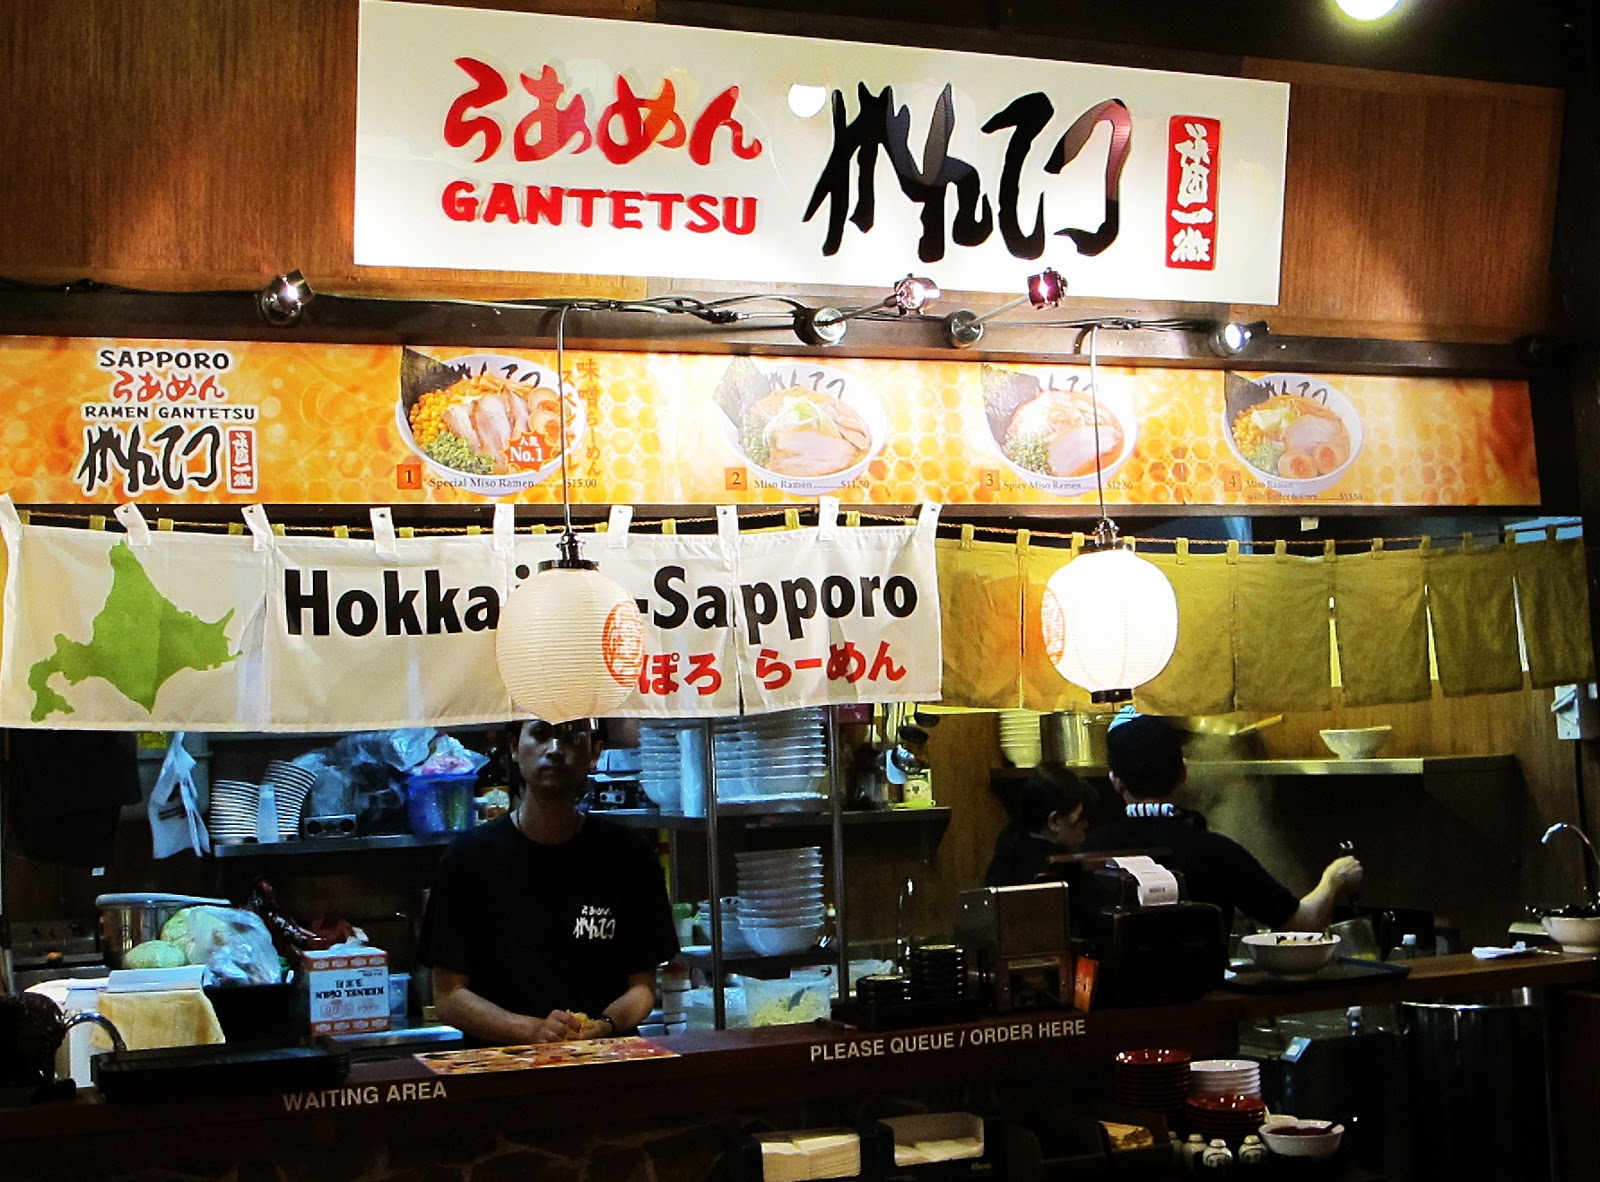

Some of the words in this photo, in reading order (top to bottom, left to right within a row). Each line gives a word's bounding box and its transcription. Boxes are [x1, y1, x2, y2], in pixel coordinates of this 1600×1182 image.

[443, 56, 763, 166] らあめん
[442, 180, 758, 236] GANTETSU
[100, 350, 230, 370] SAPPORO
[112, 370, 225, 402] らあめん
[85, 405, 149, 418] RAMEN
[158, 407, 255, 421] GANTETSU
[509, 446, 543, 463] No.1
[404, 469, 413, 484] 1
[429, 477, 468, 489] Special
[470, 478, 496, 488] Miso
[499, 477, 534, 488] Ramen
[732, 471, 741, 485] 2
[754, 479, 778, 489] Miso
[780, 479, 813, 489] Ramen
[985, 473, 994, 486] 3
[1228, 474, 1237, 487] 4
[1003, 481, 1027, 491] Spicy
[1030, 481, 1051, 490] Miso
[1053, 480, 1082, 490] Ramen
[756, 640, 907, 691] らーめん
[810, 1038, 885, 1062] PLEASE
[890, 1031, 955, 1054] QUEUE
[970, 1023, 1033, 1045] ORDER
[1038, 1019, 1086, 1039] HERE
[283, 1086, 379, 1112] WAITING
[386, 1081, 448, 1102] AREA
